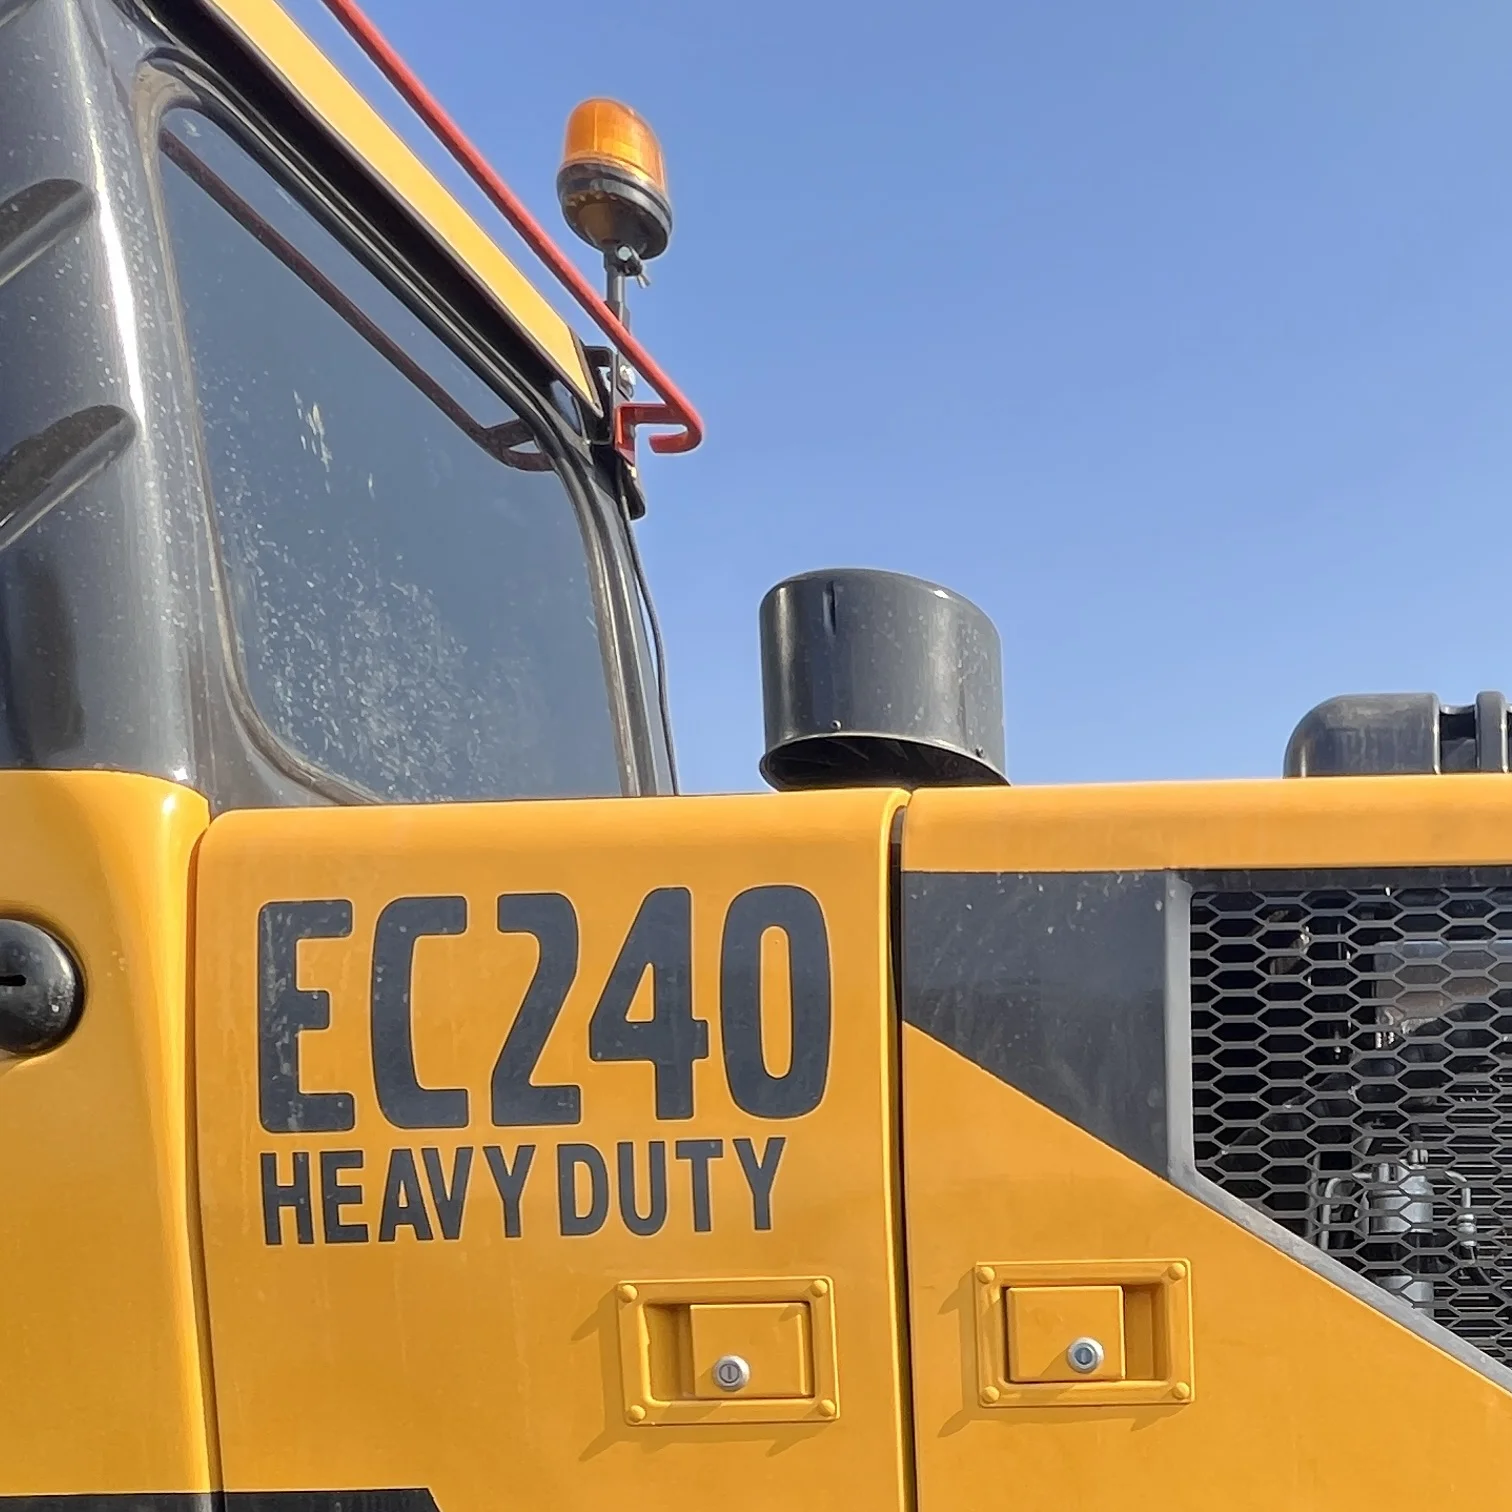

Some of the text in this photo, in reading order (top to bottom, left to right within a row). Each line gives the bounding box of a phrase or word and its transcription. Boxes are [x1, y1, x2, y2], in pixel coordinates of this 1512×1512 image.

[257, 885, 832, 1133] EC240
[259, 1137, 787, 1245] HEAVY DUTY
